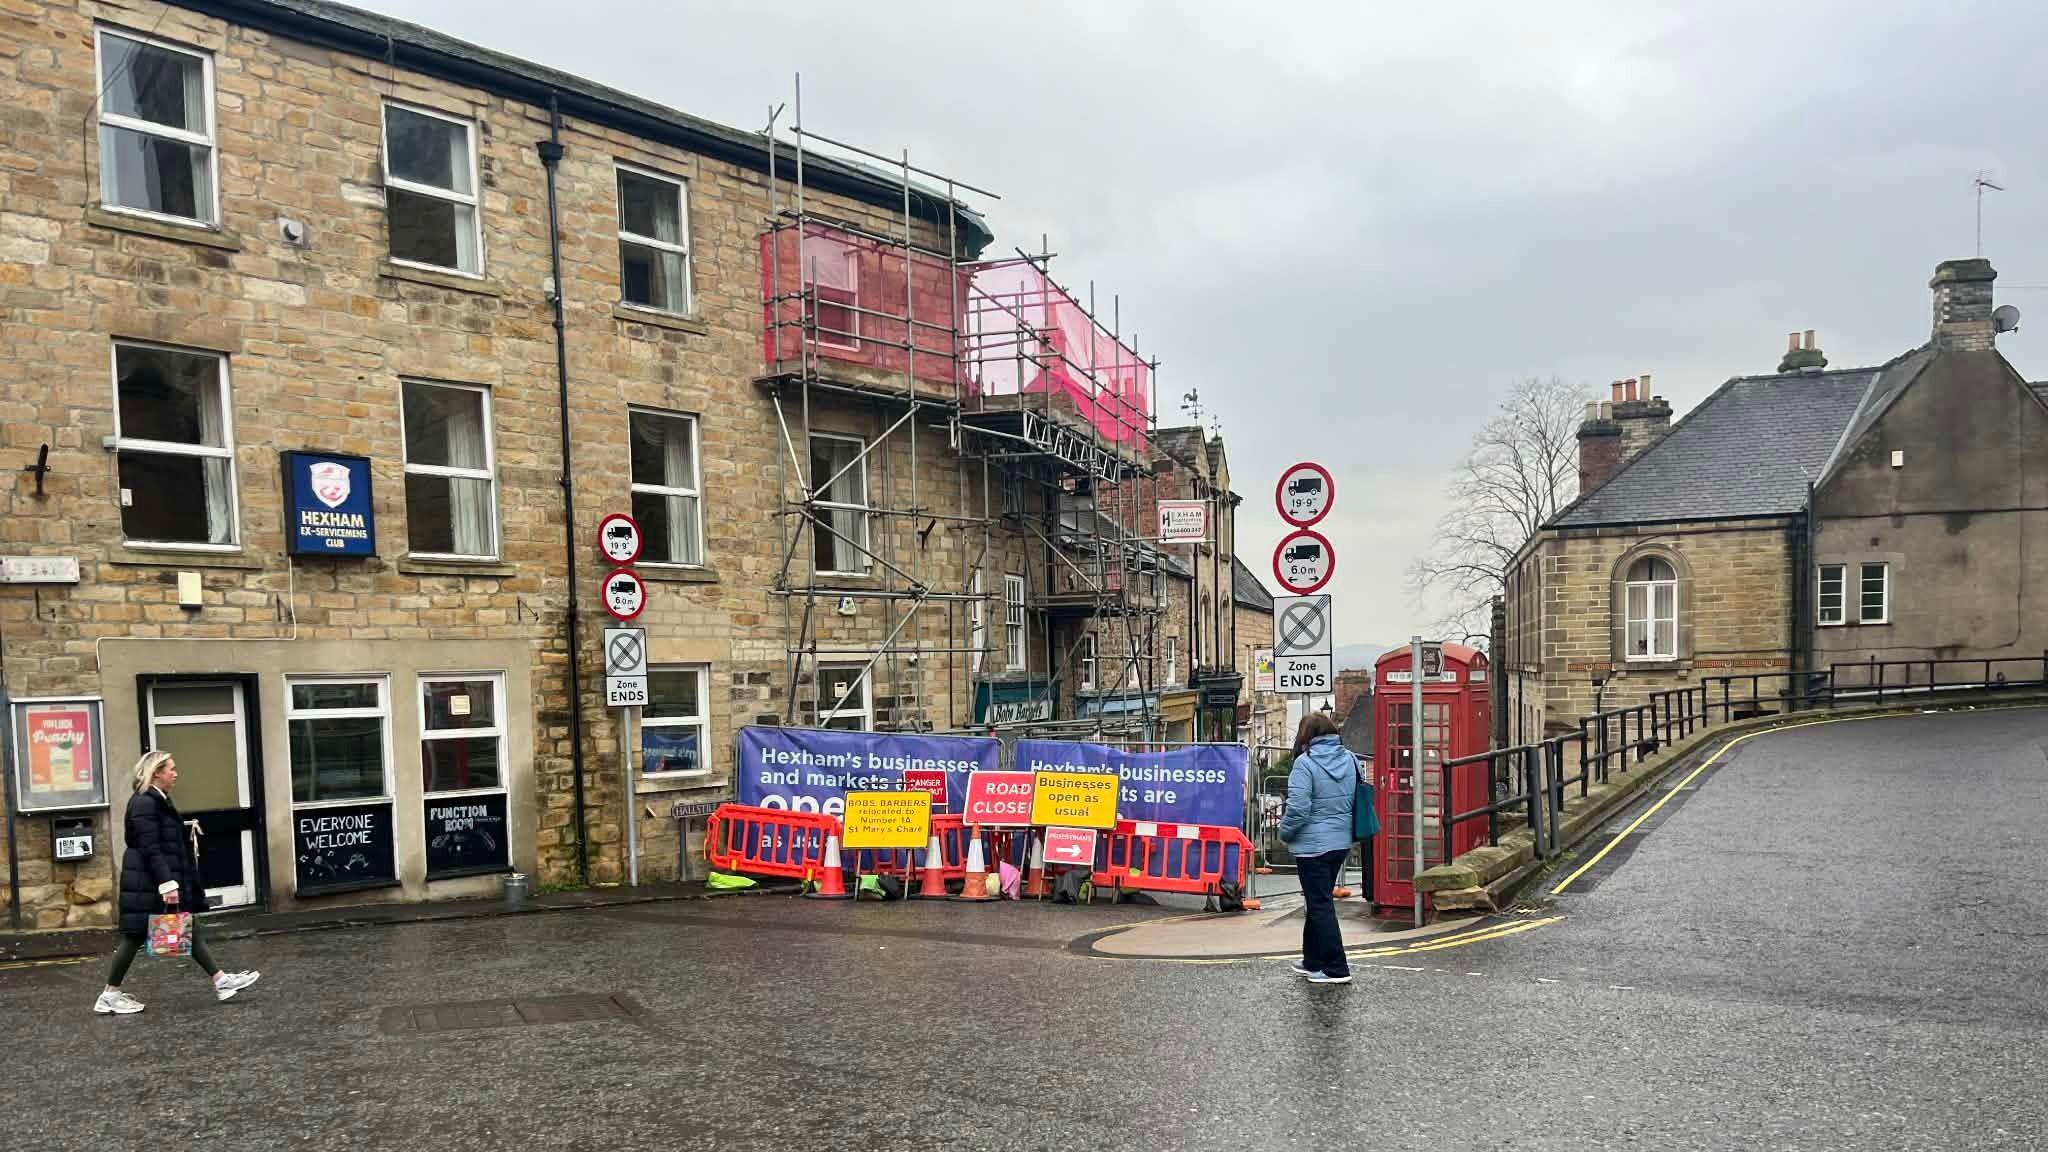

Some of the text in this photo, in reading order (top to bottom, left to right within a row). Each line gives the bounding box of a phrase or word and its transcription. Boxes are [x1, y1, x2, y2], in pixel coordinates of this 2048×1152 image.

[301, 510, 365, 528] HEXHAM
[300, 526, 368, 539] EX-SERVICEMENS
[325, 538, 345, 548] CLUB
[1288, 661, 1317, 671] Zone
[616, 680, 638, 689] Zone
[1280, 674, 1325, 687] ENDS
[611, 691, 644, 701] ENDS
[761, 747, 979, 773] Hexham's businesses
[760, 769, 800, 786] and
[806, 771, 889, 790] markets
[1119, 763, 1226, 784] businesses
[985, 782, 1032, 796] ROAD
[1039, 776, 1112, 790] Businesses
[1048, 792, 1099, 803] open as
[1143, 789, 1177, 804] are
[880, 799, 927, 808] BARBERS
[973, 801, 1031, 815] CLOSE
[430, 805, 488, 821] FUNCTION
[859, 807, 915, 815] relocated to
[1055, 806, 1089, 817] usual
[300, 813, 375, 834] EVERYONE
[444, 818, 474, 832] ROOM
[860, 816, 897, 824] Number
[848, 825, 859, 834] St
[305, 830, 373, 850] WELCOME
